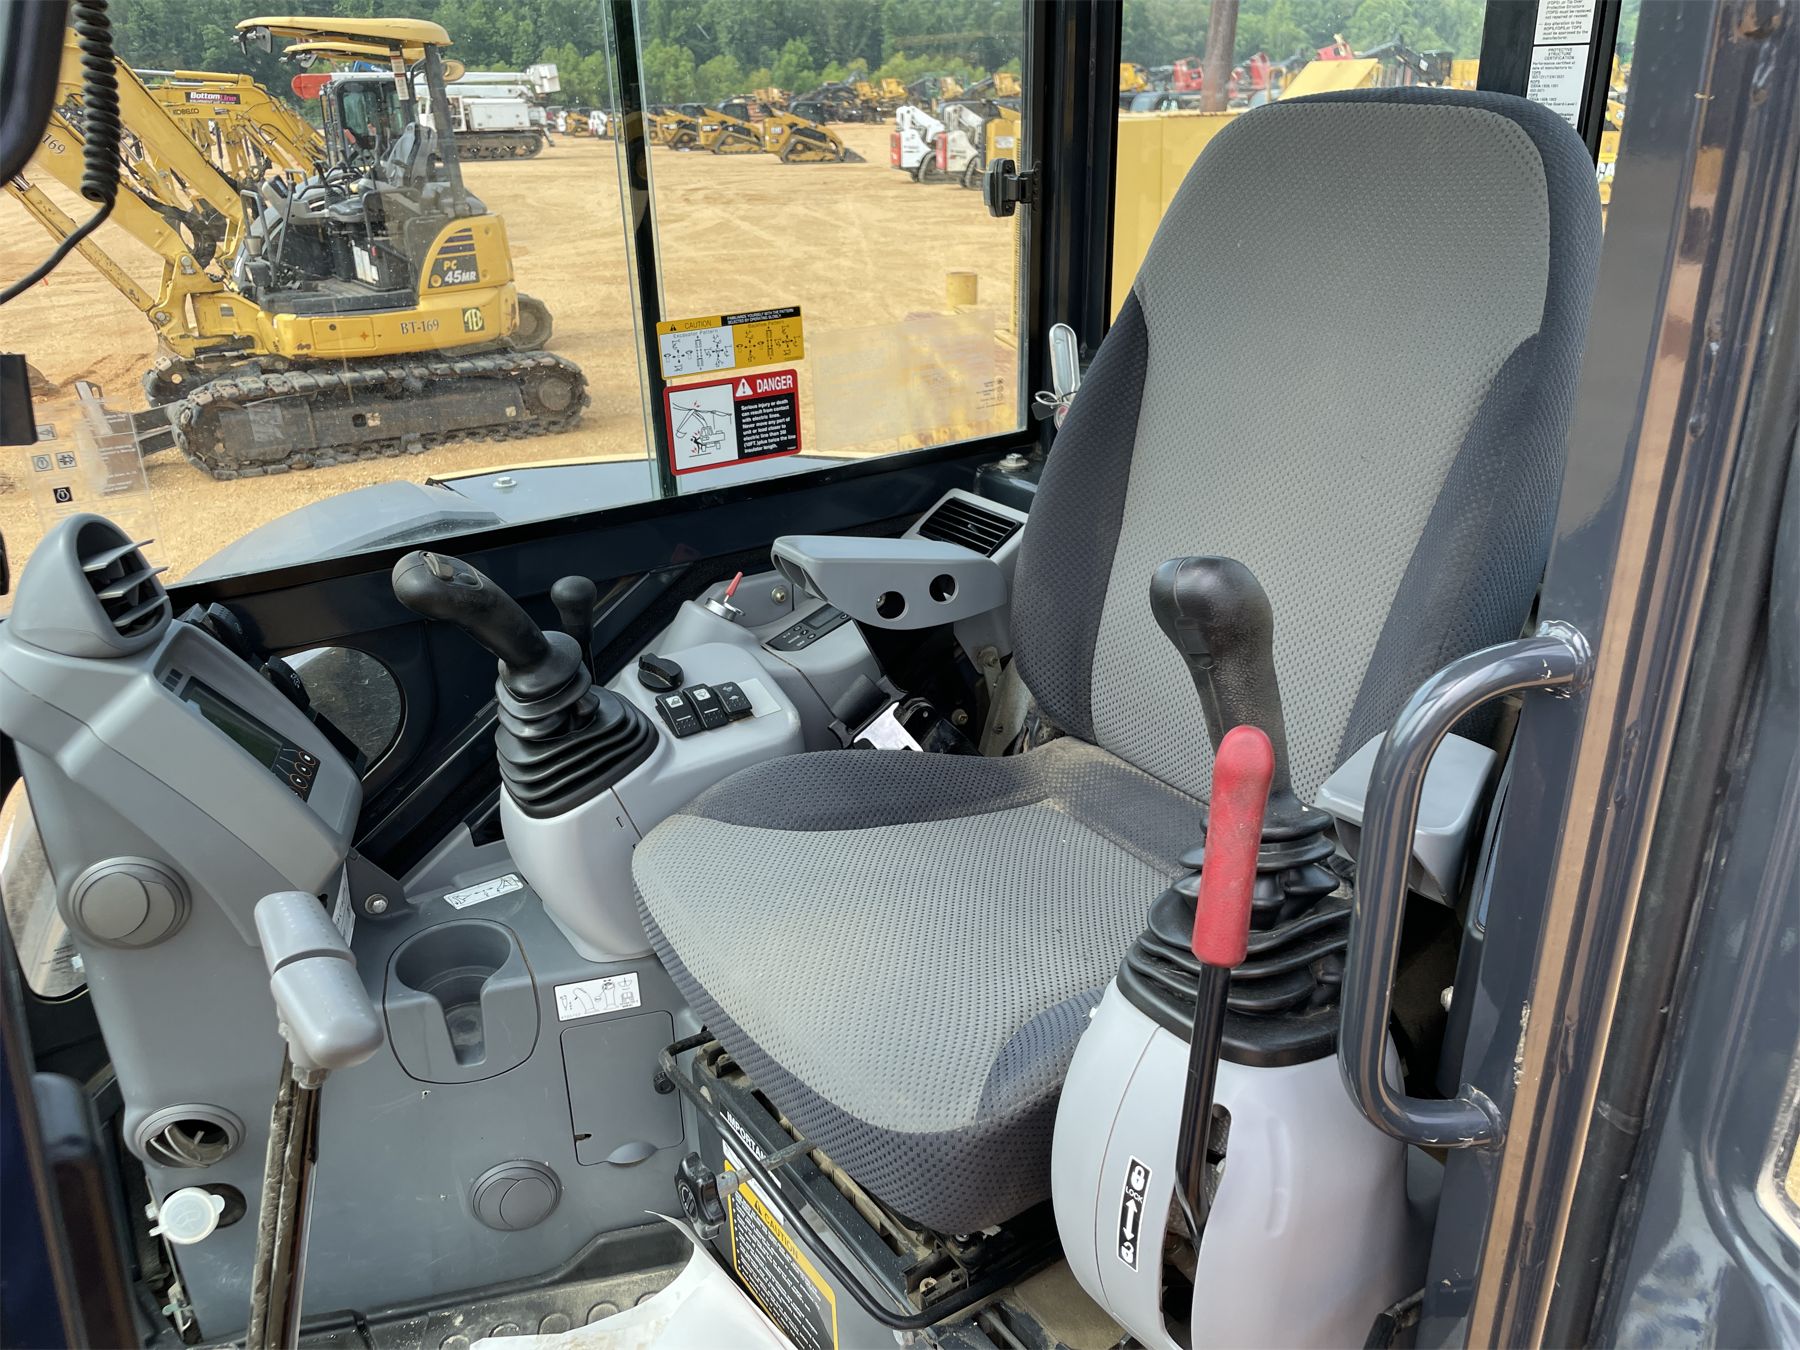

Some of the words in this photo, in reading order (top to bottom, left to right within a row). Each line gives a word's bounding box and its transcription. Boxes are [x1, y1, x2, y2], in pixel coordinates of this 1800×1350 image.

[444, 260, 457, 270] PC
[444, 270, 476, 283] 45MR
[401, 320, 439, 335] BT-169
[684, 320, 712, 329] CAUTION
[673, 331, 698, 339] Excavator
[756, 375, 793, 393] DANGER
[726, 1110, 766, 1161] IMPORTAN
[1126, 1186, 1143, 1204] LOCK
[764, 1212, 800, 1260] CAUTION
